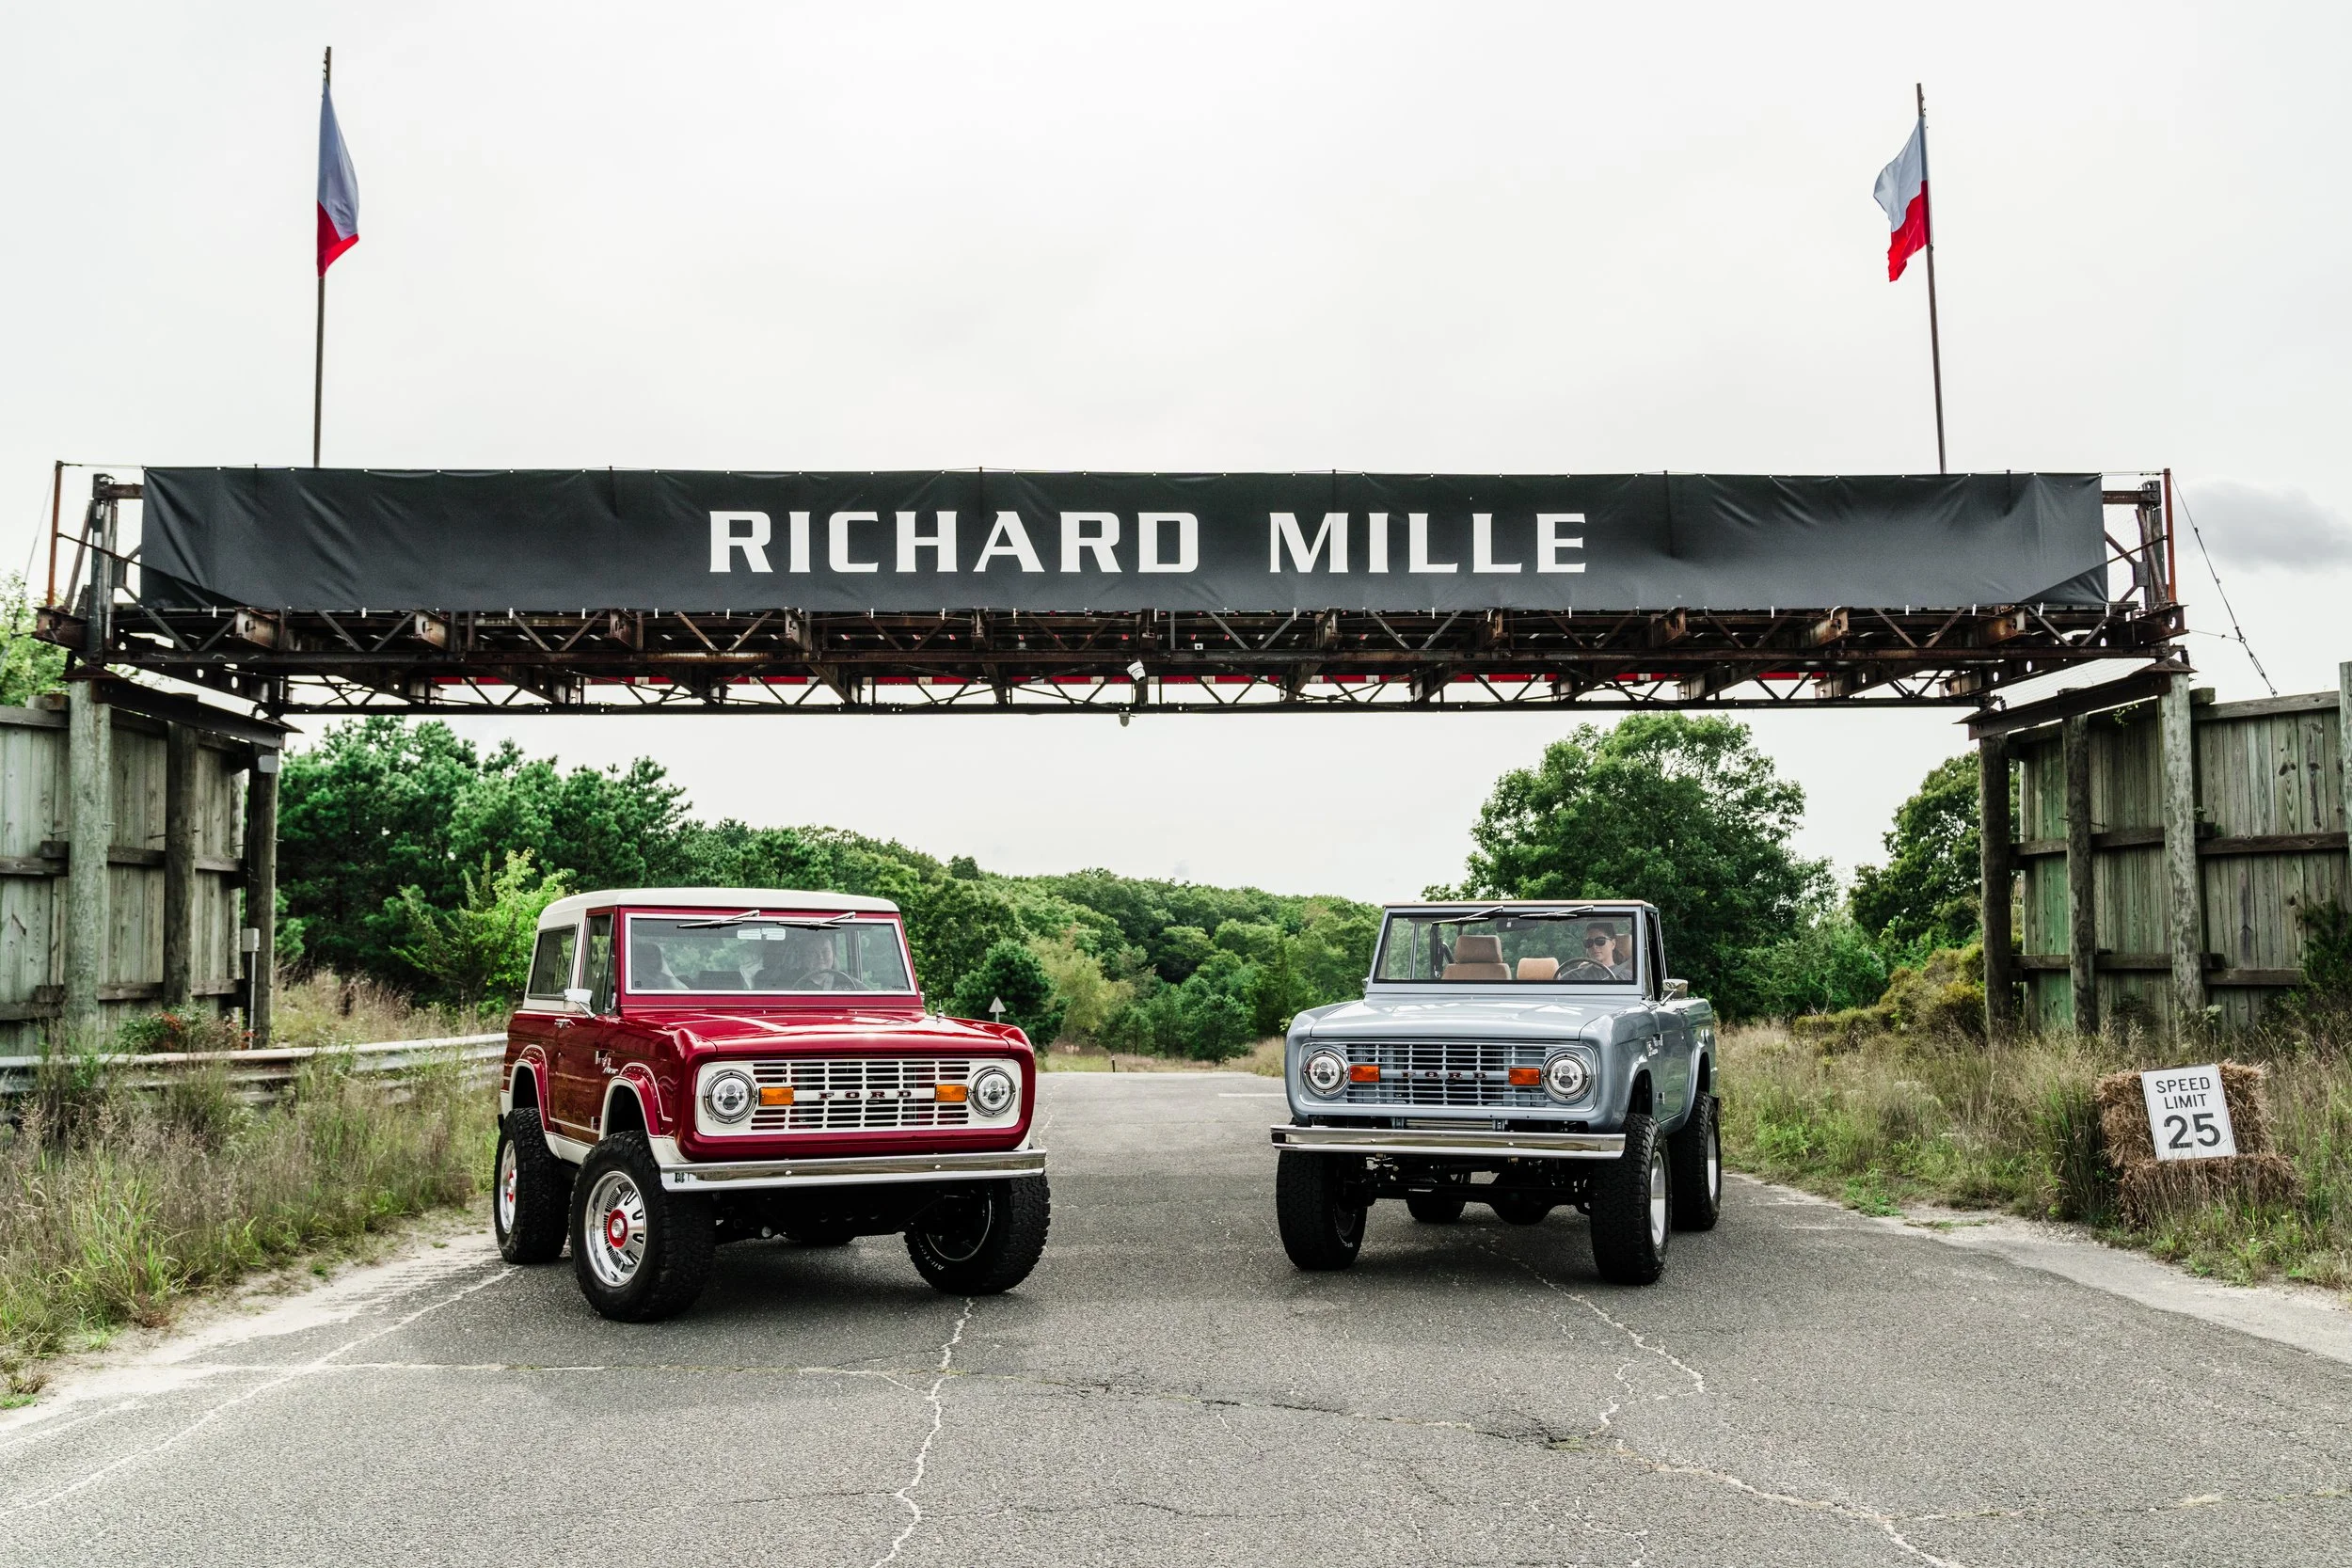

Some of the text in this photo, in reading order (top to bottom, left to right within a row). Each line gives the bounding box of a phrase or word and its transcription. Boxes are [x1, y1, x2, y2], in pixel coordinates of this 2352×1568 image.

[708, 510, 1587, 574] RICHARD MILLE
[1401, 1070, 1486, 1080] FORD
[2155, 1076, 2211, 1093] SPEED
[818, 1090, 912, 1100] FORD
[2164, 1094, 2207, 1110] LIMIT
[2163, 1112, 2221, 1149] 25
